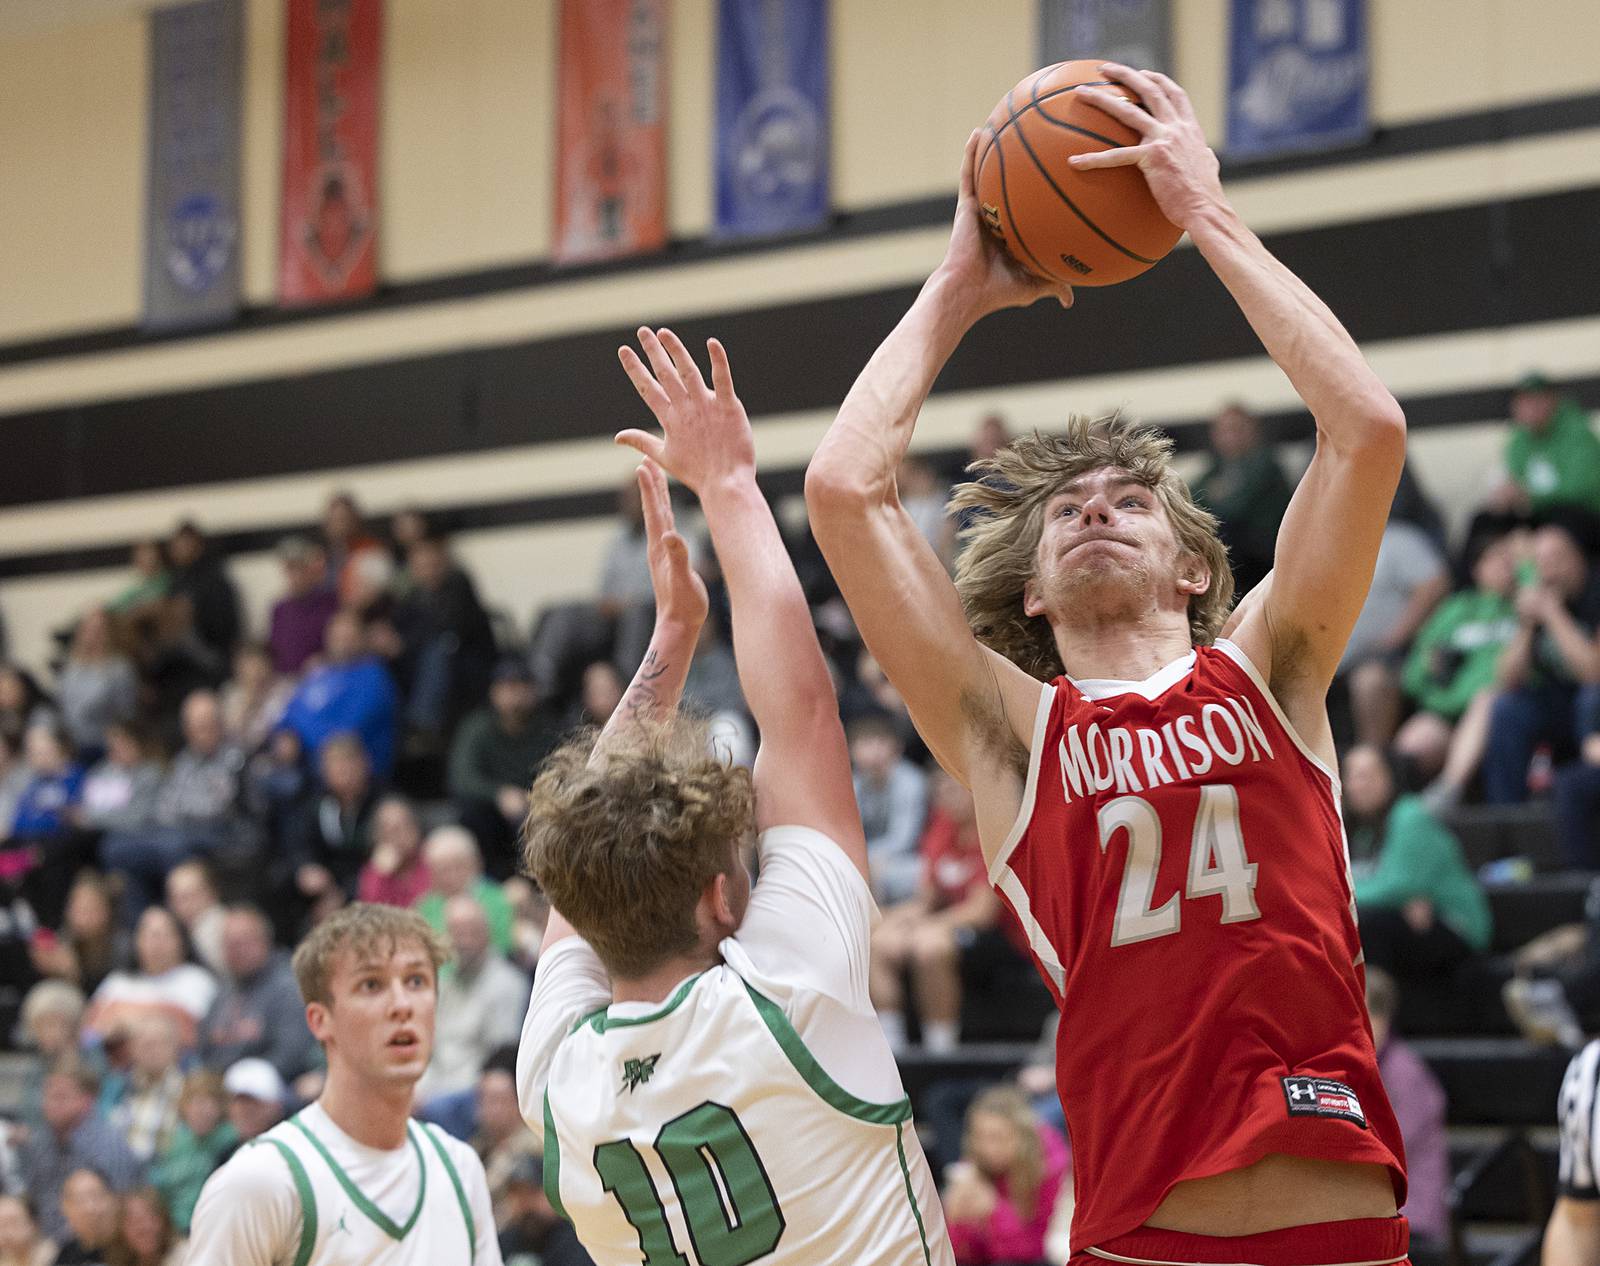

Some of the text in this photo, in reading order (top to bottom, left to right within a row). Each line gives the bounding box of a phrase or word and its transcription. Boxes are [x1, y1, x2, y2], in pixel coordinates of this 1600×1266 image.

[1059, 695, 1274, 804] MORRISON
[1097, 784, 1261, 948] 24
[593, 1100, 786, 1266] 10
